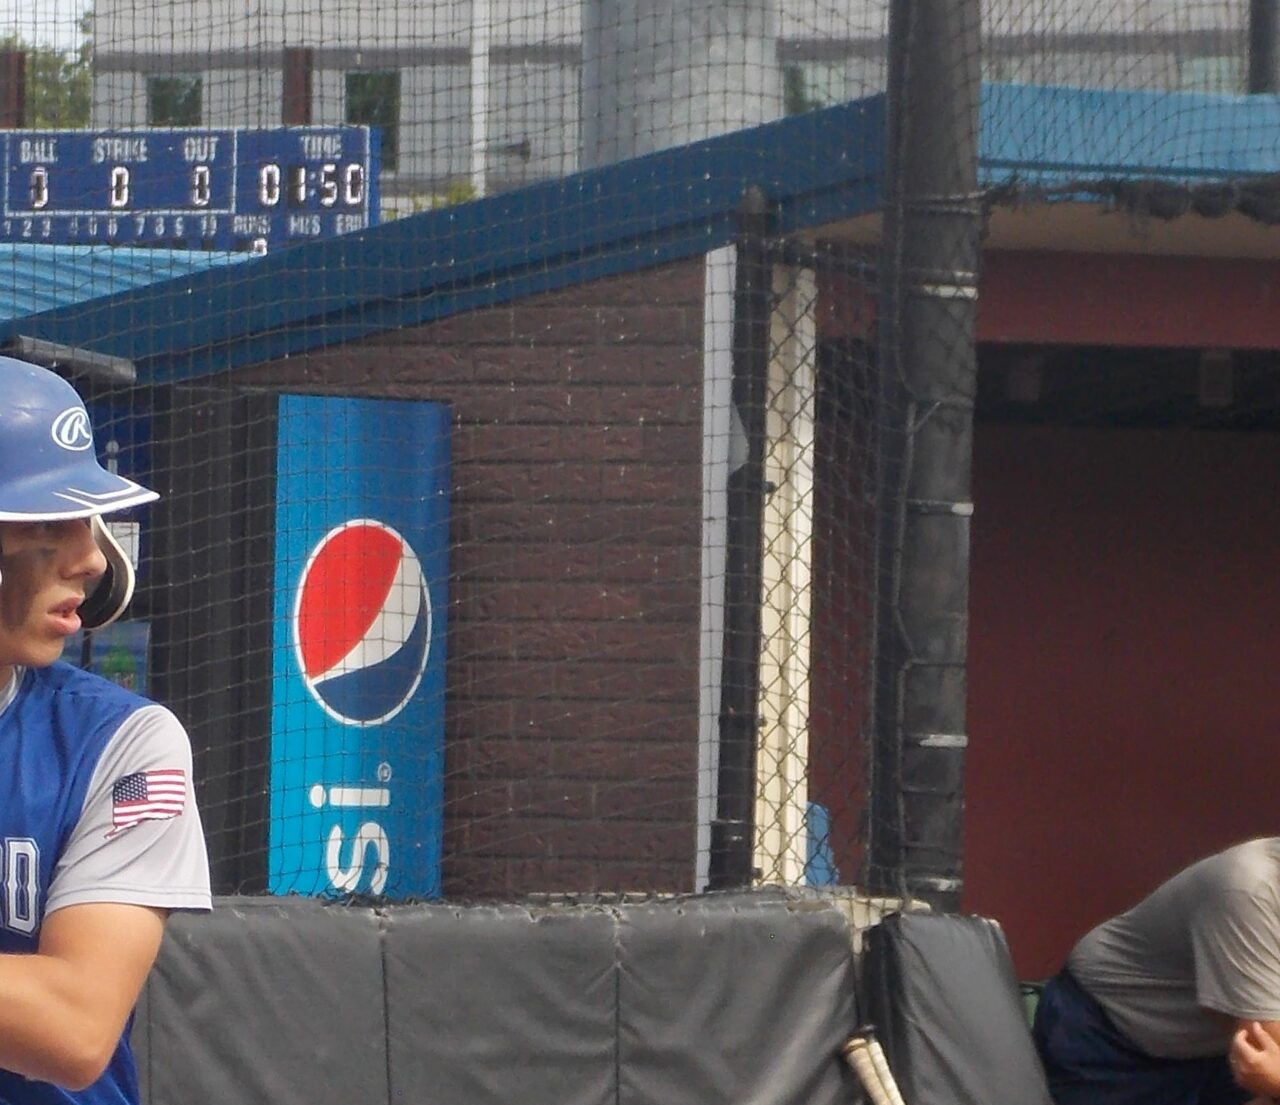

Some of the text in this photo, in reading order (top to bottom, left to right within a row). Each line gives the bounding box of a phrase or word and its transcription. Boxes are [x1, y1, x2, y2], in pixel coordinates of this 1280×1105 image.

[94, 138, 148, 163] STRIKE
[184, 137, 219, 162] OUT
[300, 135, 342, 159] TIME
[31, 166, 210, 208] 0 0 0
[260, 164, 364, 206] 01:50
